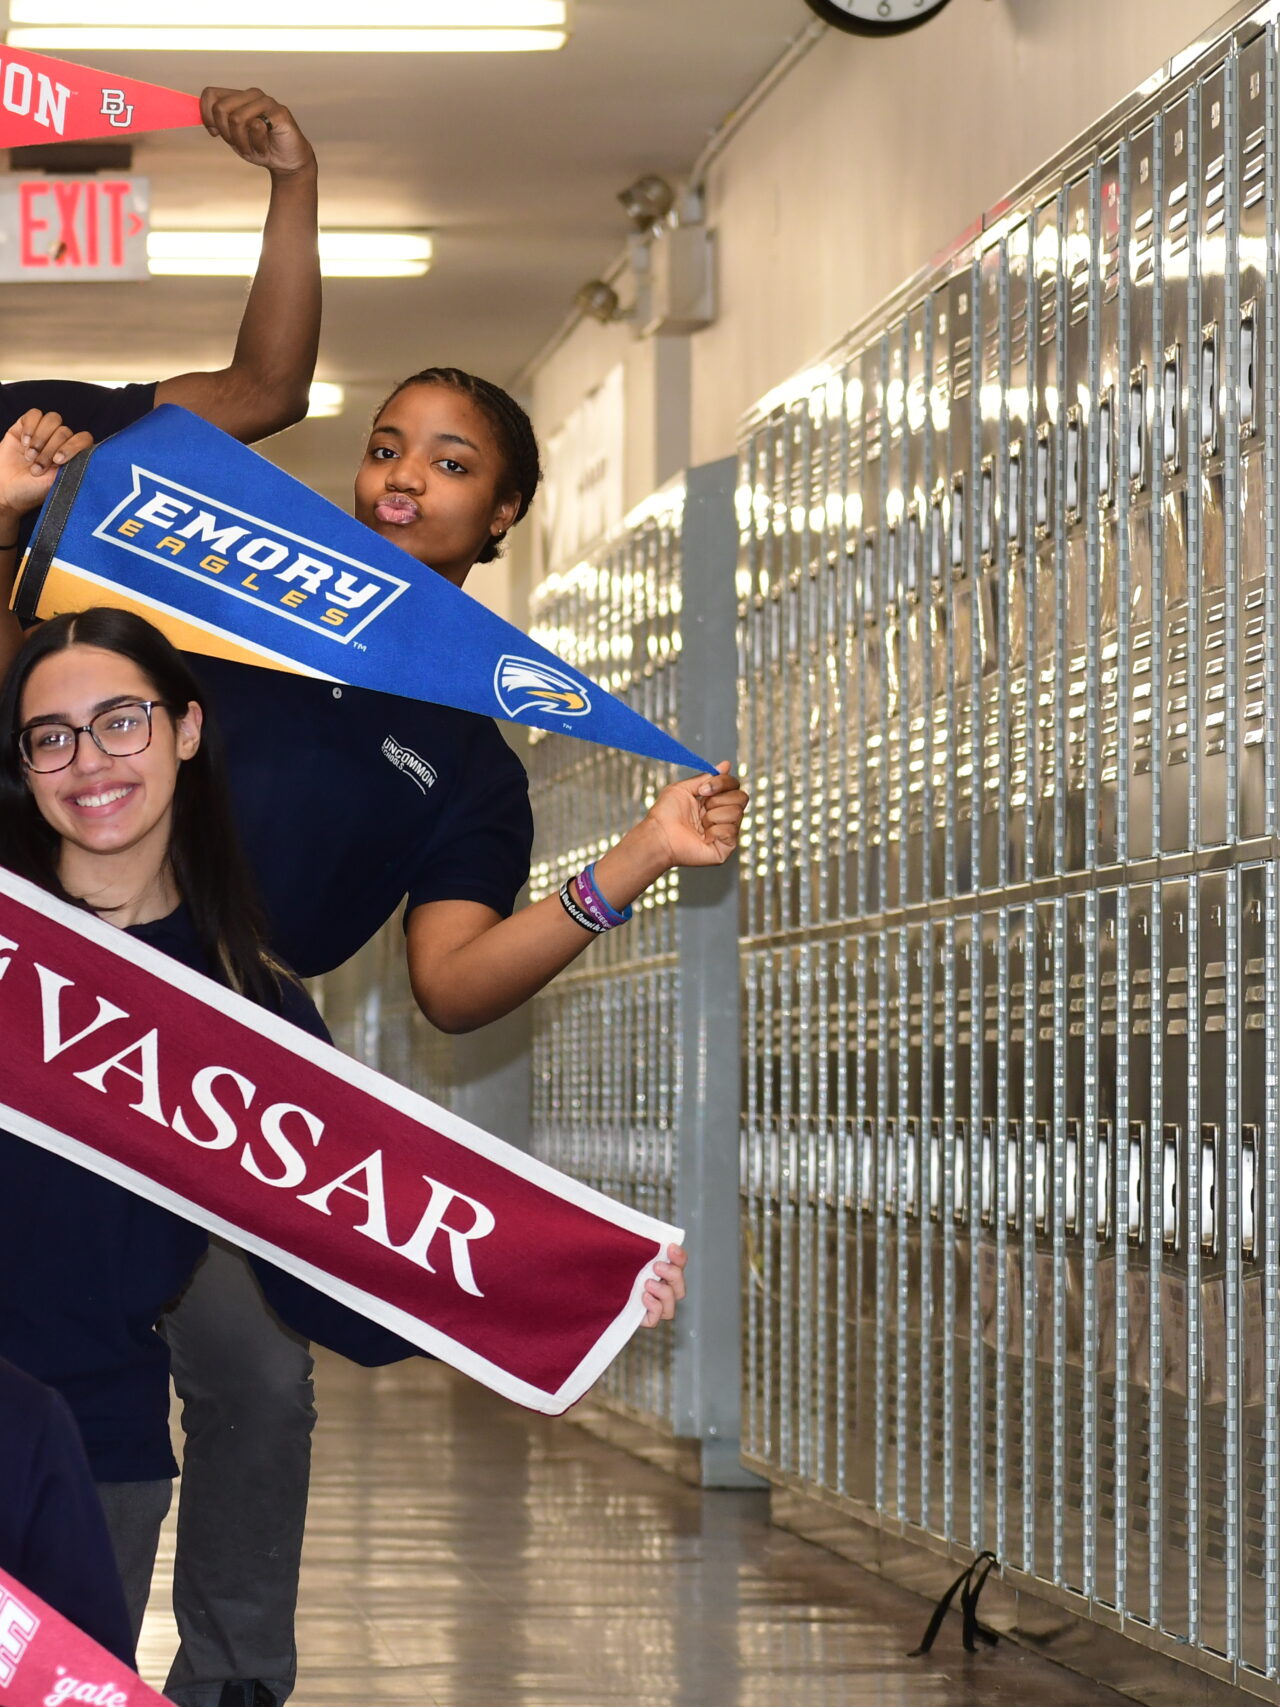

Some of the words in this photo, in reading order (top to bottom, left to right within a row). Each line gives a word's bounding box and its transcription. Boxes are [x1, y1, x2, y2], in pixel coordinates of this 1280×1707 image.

[100, 88, 134, 127] BU
[19, 181, 131, 267] EXIT
[117, 518, 350, 627] EAGLES
[134, 490, 382, 610] EMORY
[381, 745, 404, 770] SCHOOLS
[383, 737, 435, 788] UNCOMMON
[32, 961, 497, 1298] VASSAR
